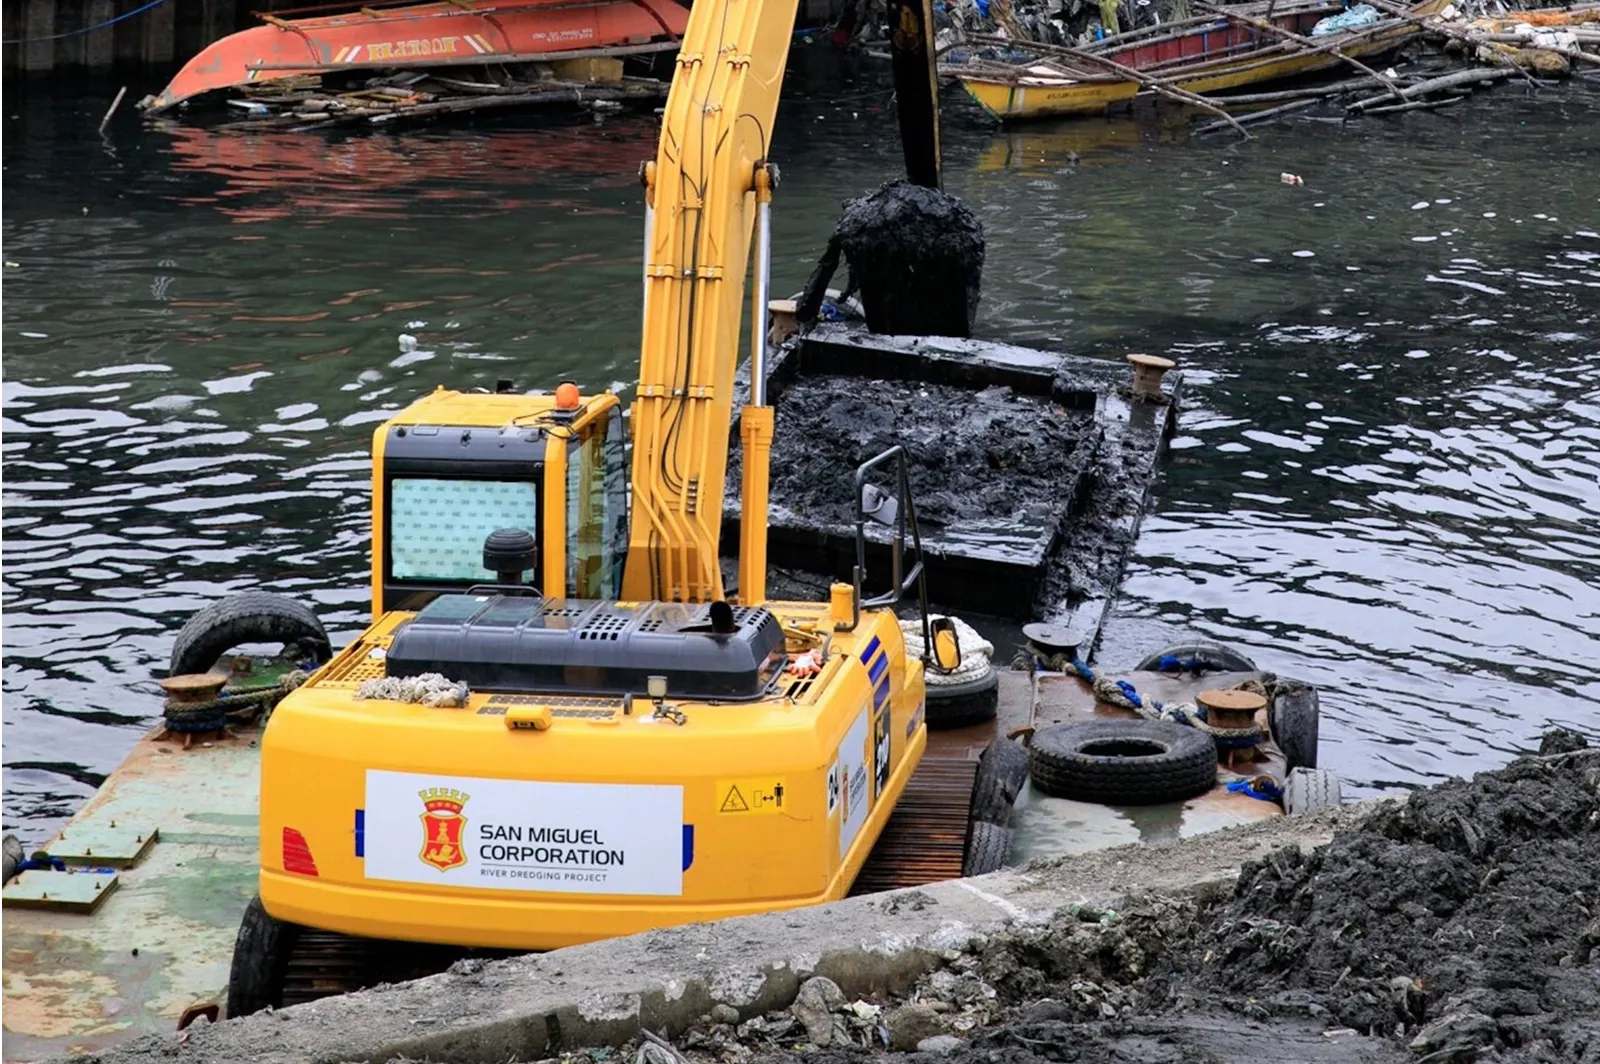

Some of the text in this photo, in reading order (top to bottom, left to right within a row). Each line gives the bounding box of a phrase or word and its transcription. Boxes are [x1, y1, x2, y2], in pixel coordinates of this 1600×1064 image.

[480, 824, 604, 845] SAN MIGUEL
[480, 844, 624, 866] CORPORATION
[480, 869, 608, 882] RIVER DREDGING PROJECT
